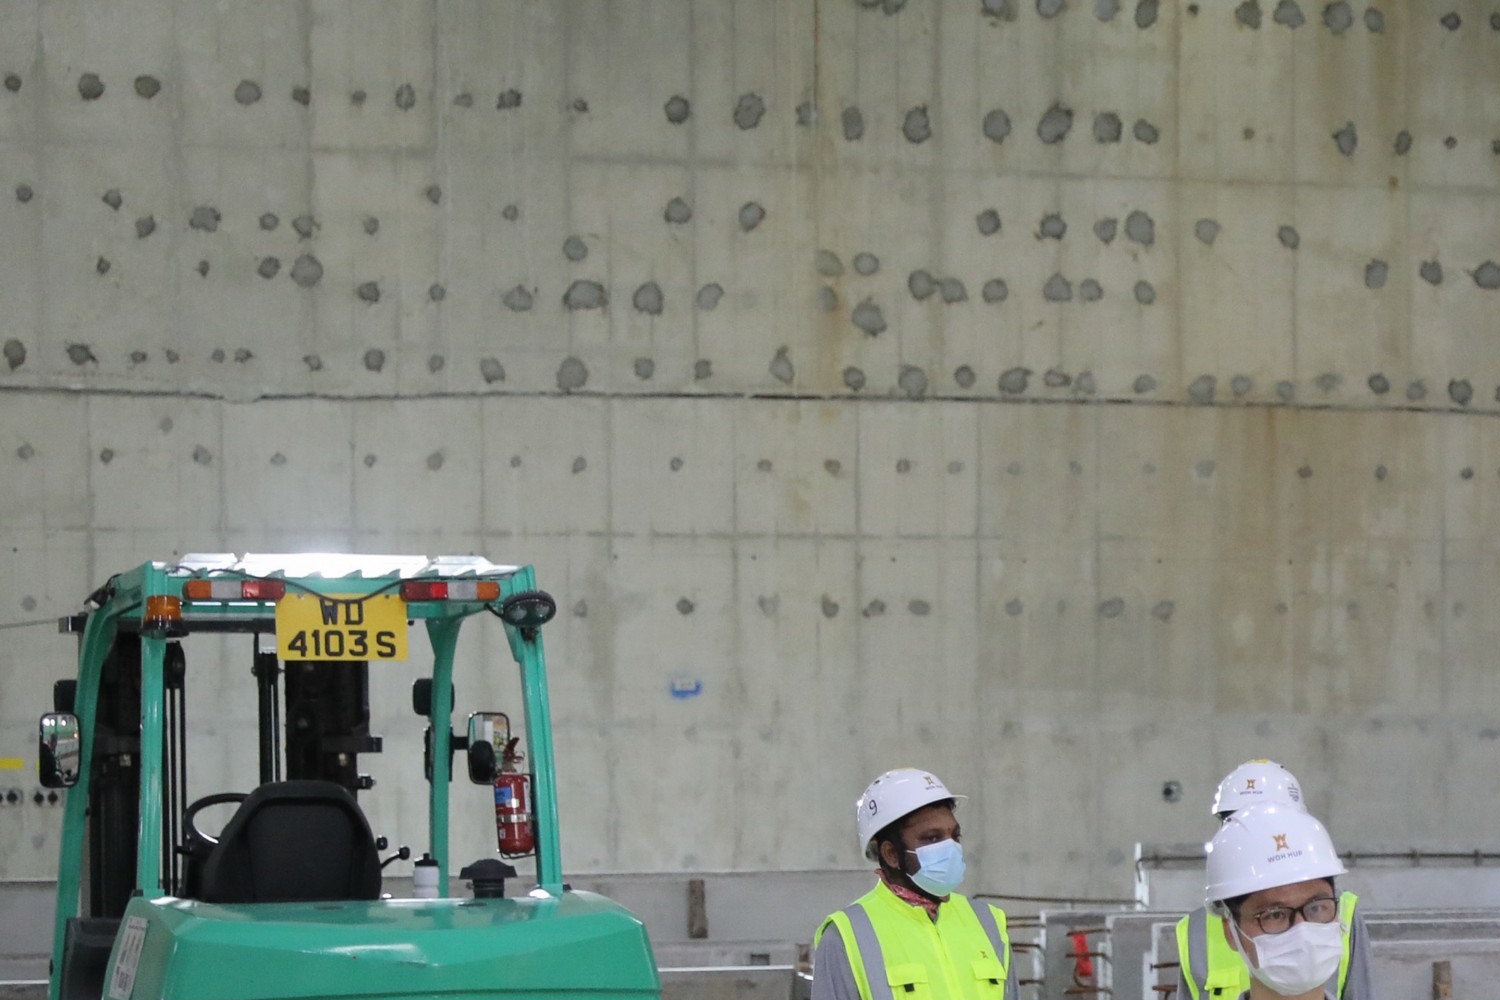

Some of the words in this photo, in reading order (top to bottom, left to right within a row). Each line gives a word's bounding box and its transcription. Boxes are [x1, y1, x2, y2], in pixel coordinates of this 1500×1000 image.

[319, 599, 364, 625] WD
[868, 799, 878, 816] 9
[1267, 853, 1287, 863] WOH
[1287, 850, 1303, 858] HUP
